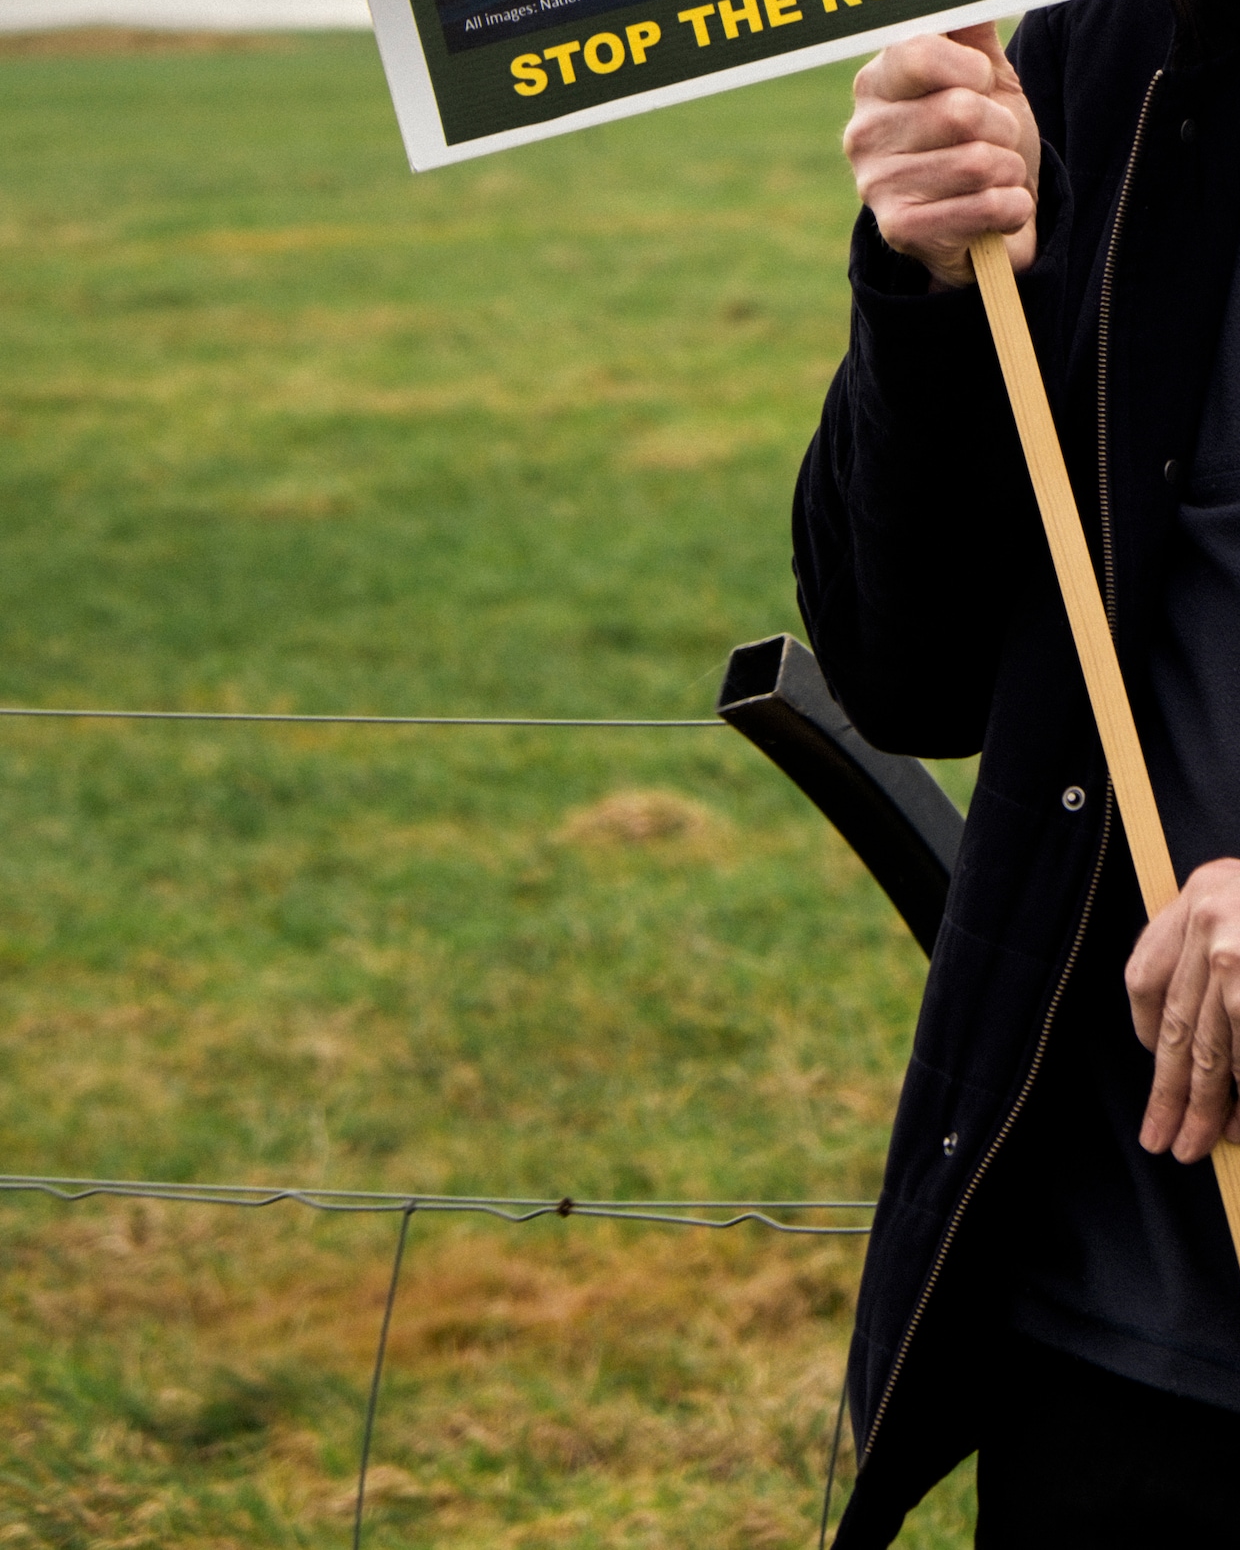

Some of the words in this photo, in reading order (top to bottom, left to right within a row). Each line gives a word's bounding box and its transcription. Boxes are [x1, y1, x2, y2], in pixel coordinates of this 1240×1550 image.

[464, 15, 483, 32] All
[485, 4, 538, 24] images:
[510, 20, 662, 97] STOP
